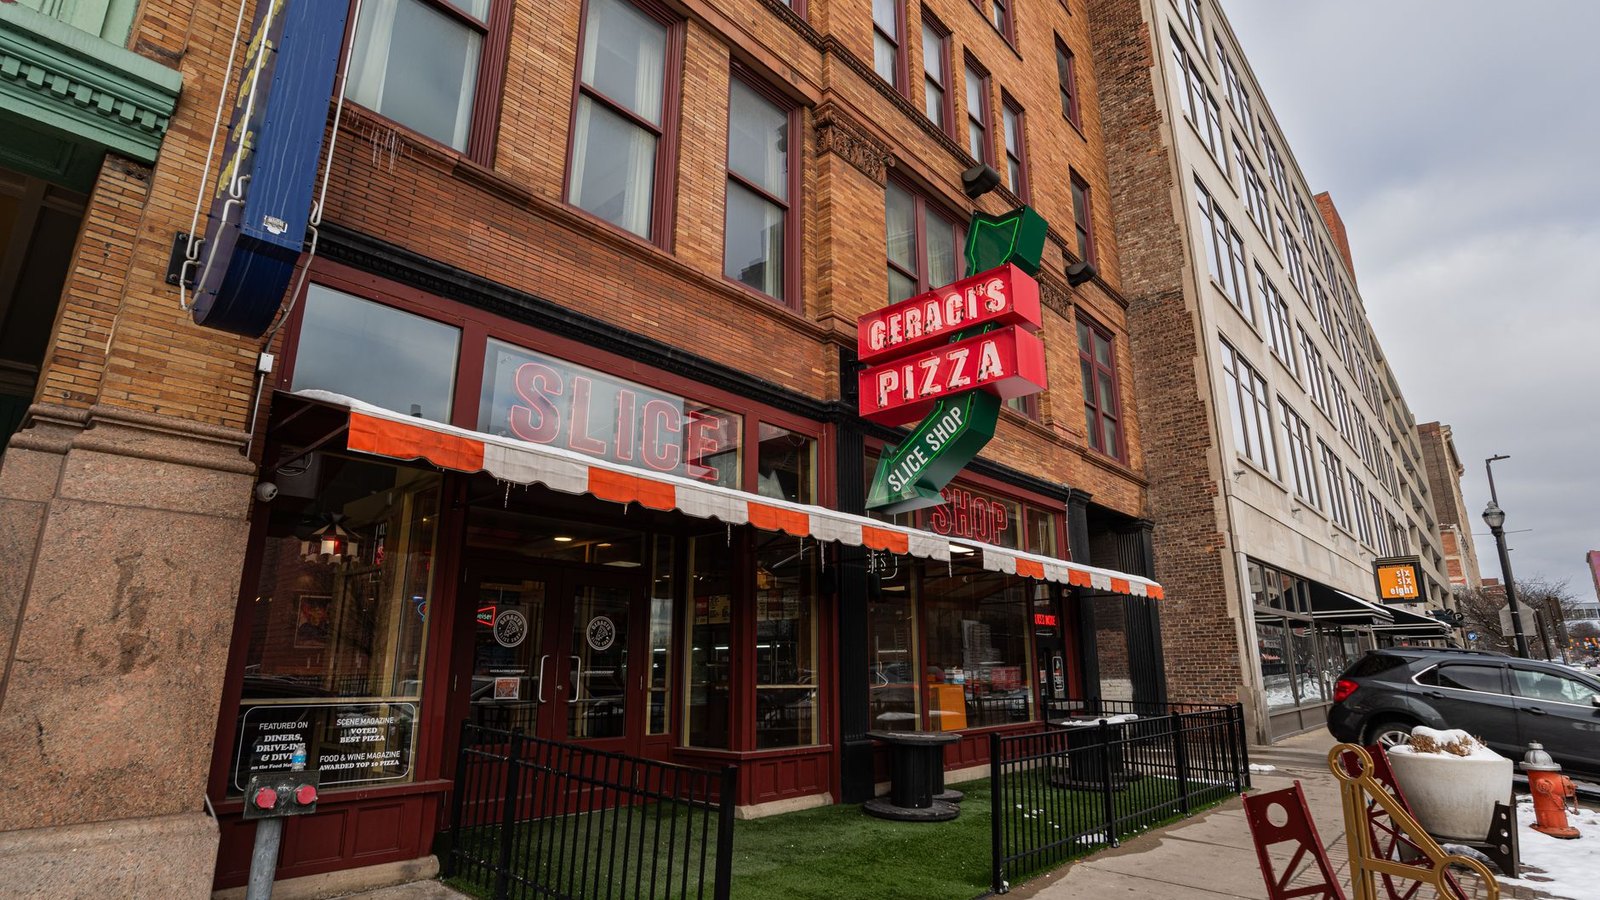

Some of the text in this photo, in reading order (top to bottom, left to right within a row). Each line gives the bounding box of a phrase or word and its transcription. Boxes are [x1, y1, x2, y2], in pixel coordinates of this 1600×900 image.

[868, 278, 1007, 351] GERACI'S
[876, 340, 1004, 409] PIZZA
[509, 362, 719, 481] SLICE
[887, 405, 962, 493] SLICE SHOP
[932, 487, 1008, 545] SHOP
[1390, 585, 1414, 596] eight
[259, 721, 309, 730] FEATURED ON
[336, 717, 394, 726] SCENE MAGAZINE
[264, 733, 303, 742] DINERS,
[256, 743, 306, 752] DRIVE-IN
[261, 754, 270, 762] &
[319, 754, 340, 762] FOOD
[347, 752, 366, 761] WINE
[366, 750, 400, 760] MAGAZINE
[318, 762, 355, 771] AWARDED
